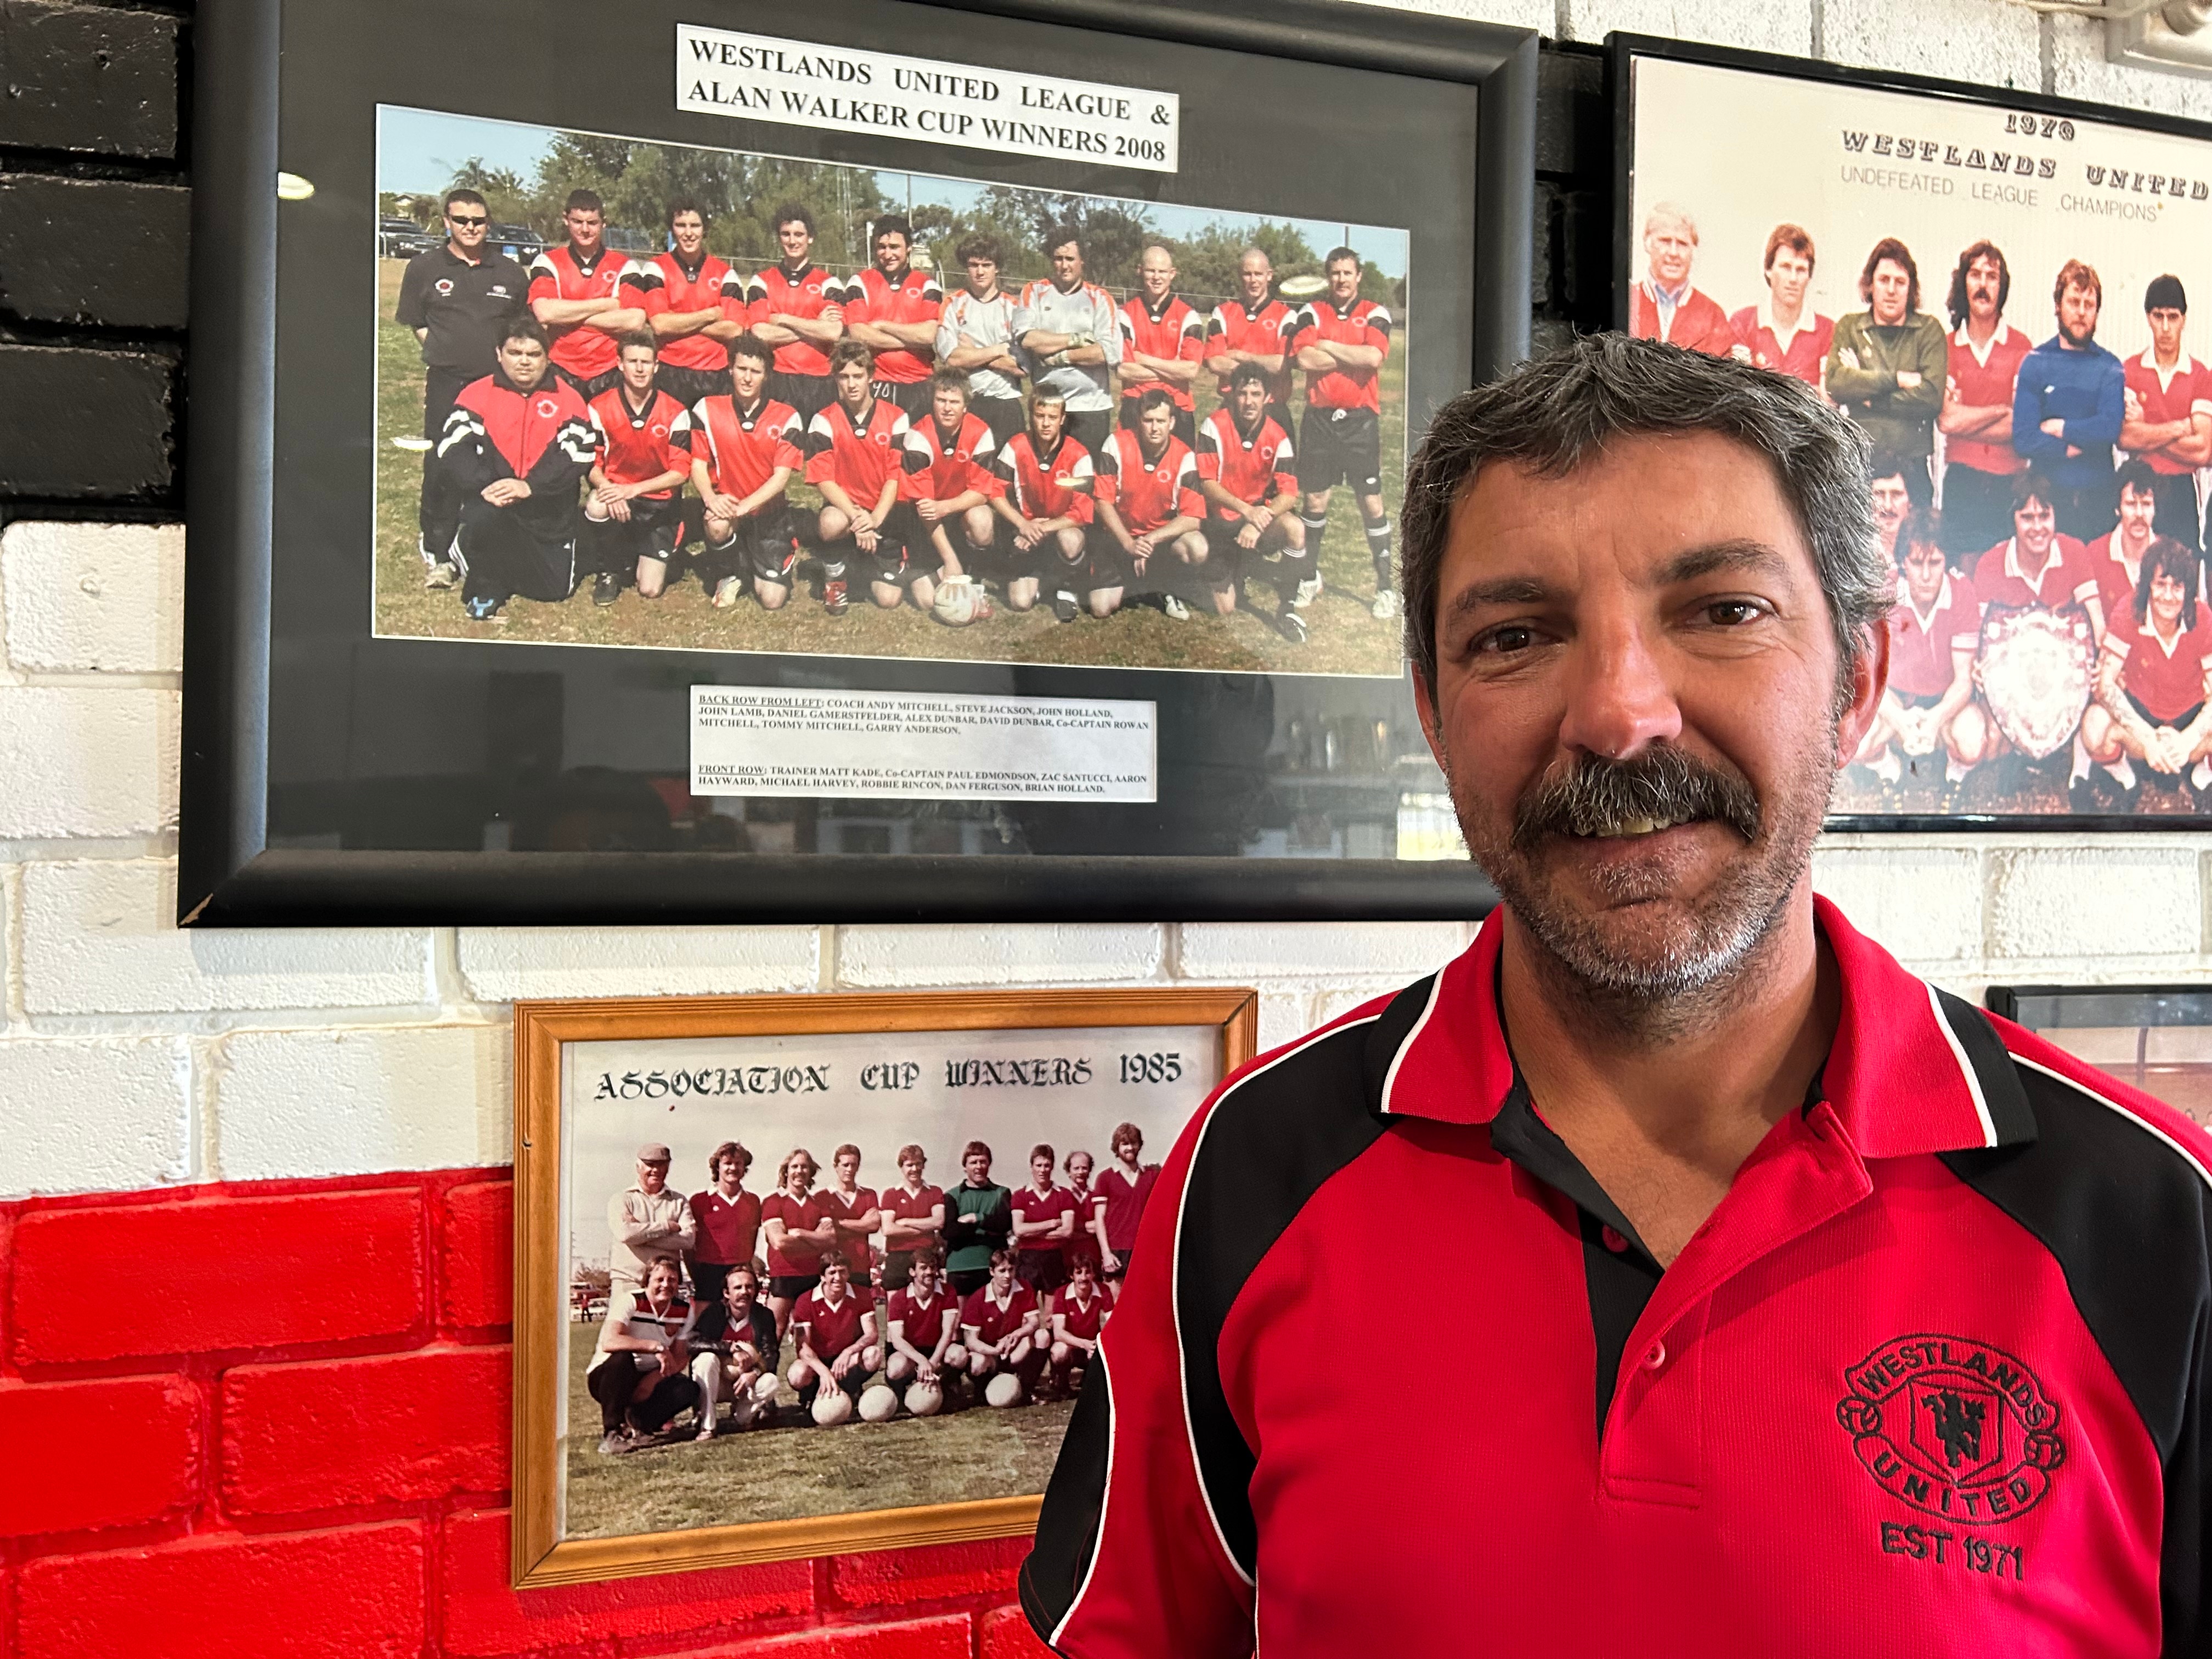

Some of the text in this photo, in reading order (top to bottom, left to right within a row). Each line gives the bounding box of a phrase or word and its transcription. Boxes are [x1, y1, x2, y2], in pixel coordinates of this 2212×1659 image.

[689, 40, 1170, 125] WESTLANDS UNITED LEAGUE &
[689, 81, 1165, 161] ALAN WALKER CUP WINNERS 2008
[1842, 129, 2209, 200] WESTLANDS UNITED
[1841, 165, 2157, 221] UNDEFEATED LEAGUE CHAMPIONS
[698, 707, 728, 716] JOHN
[731, 708, 765, 717] LAMB,
[768, 709, 807, 719] DANIEL
[905, 714, 931, 723] ALEX
[935, 715, 977, 724] DUNBAR,
[980, 716, 1010, 725] DAVID
[1013, 718, 1054, 726] DUNBAR,
[1057, 719, 1111, 728] Co-CAPTAIN
[1114, 721, 1148, 729] ROWAN
[699, 695, 1113, 718] BACK ROW FROM LEFT: COACH ANDY MITCHELL, STEVE JACKSON, JOHN HOLLAND,
[699, 719, 759, 729] MITCHELL,
[762, 720, 803, 730] TOMMY
[806, 721, 864, 732] MITCHELL,
[866, 724, 902, 732] GARRY
[698, 765, 1147, 783] FRONT ROW: TRAINER MATT KADE, Co-CAPTAIN PAUL EDMONDSON, ZAC SANTUCCI, AARON
[698, 777, 757, 786] HAYWARD,
[760, 778, 810, 787] MICHAEL
[813, 780, 859, 788] HARVEY,
[861, 780, 899, 789] ROBBIE
[902, 781, 943, 790] RINCON,
[946, 782, 966, 791] DAN
[969, 782, 1023, 792] FERGUSON,
[1025, 784, 1054, 792] BRIAN
[594, 1053, 1182, 1100] ASSOCIATION CUP WINNERS 1985
[1857, 1343, 2046, 1426] WESTLANDS
[1874, 1451, 2031, 1515] UNITED
[1881, 1522, 2023, 1581] EST 1971
